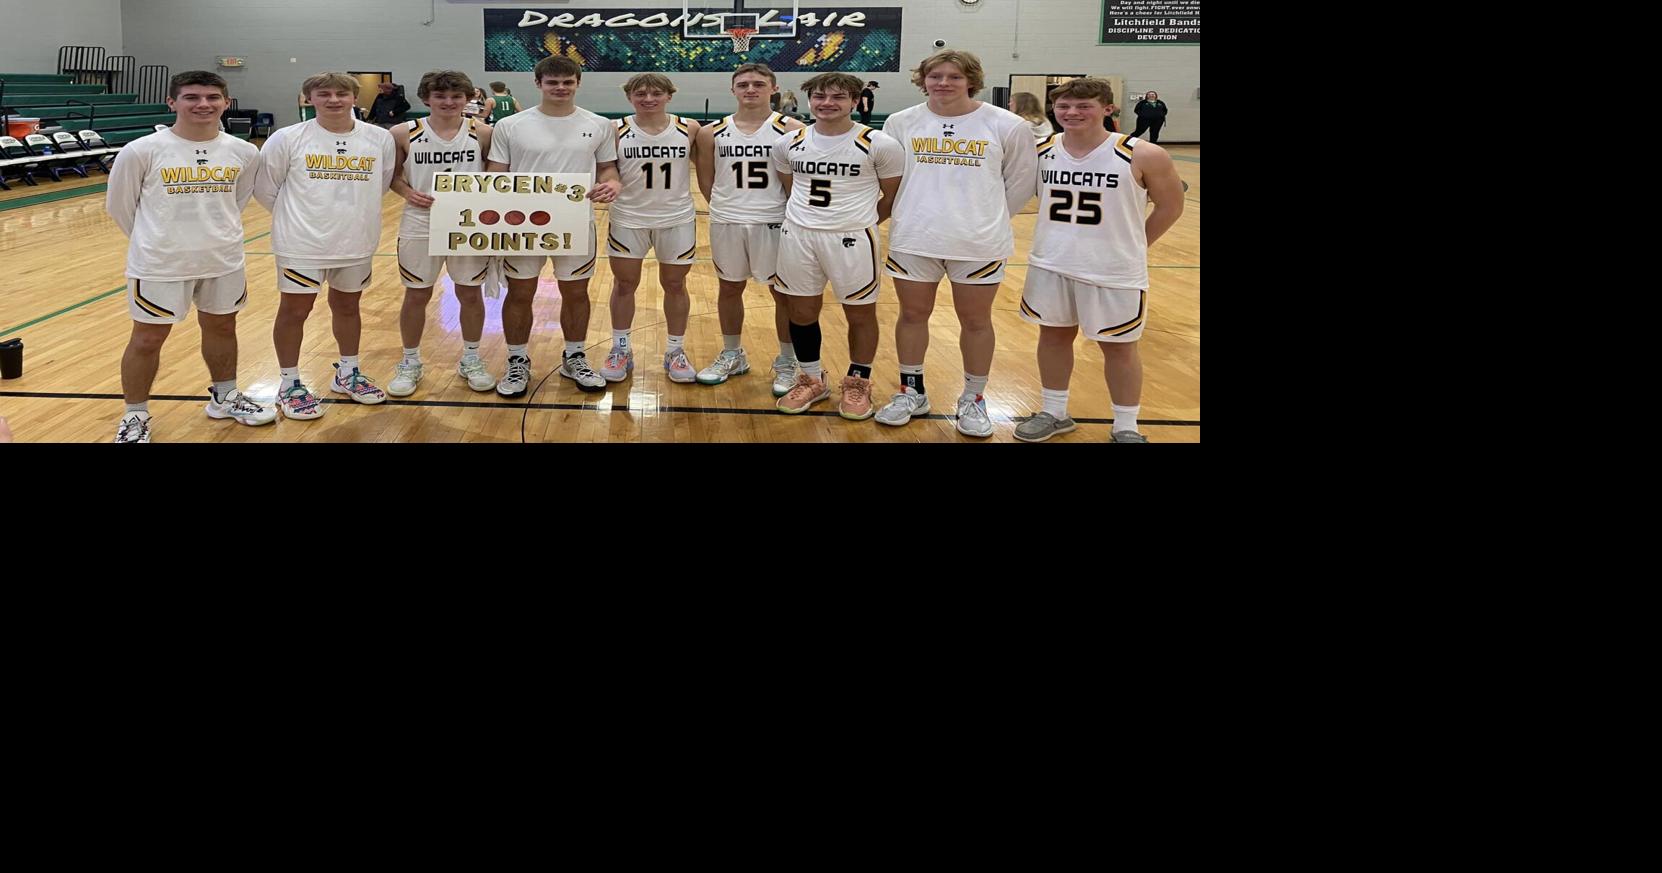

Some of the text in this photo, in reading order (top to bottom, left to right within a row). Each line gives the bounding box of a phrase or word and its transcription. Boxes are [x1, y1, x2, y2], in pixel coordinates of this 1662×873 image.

[518, 10, 724, 28] DRAGONS
[1114, 18, 1166, 26] Litchfield
[501, 101, 510, 111] 11
[623, 146, 686, 159] WILDCATS
[718, 145, 772, 158] WILDCAT
[911, 137, 989, 157] WILDCAT
[305, 153, 376, 172] WILDCAT
[414, 150, 475, 165] WILDCATS
[161, 166, 240, 184] WILDCAT
[640, 162, 672, 190] 11
[731, 161, 769, 189] 15
[790, 160, 861, 177] WILDCATS
[434, 174, 553, 194] BRYCEN
[1041, 170, 1119, 189] WILDCATS
[808, 178, 832, 208] 5
[1049, 189, 1103, 226] 25
[448, 232, 572, 251] POINTS!
